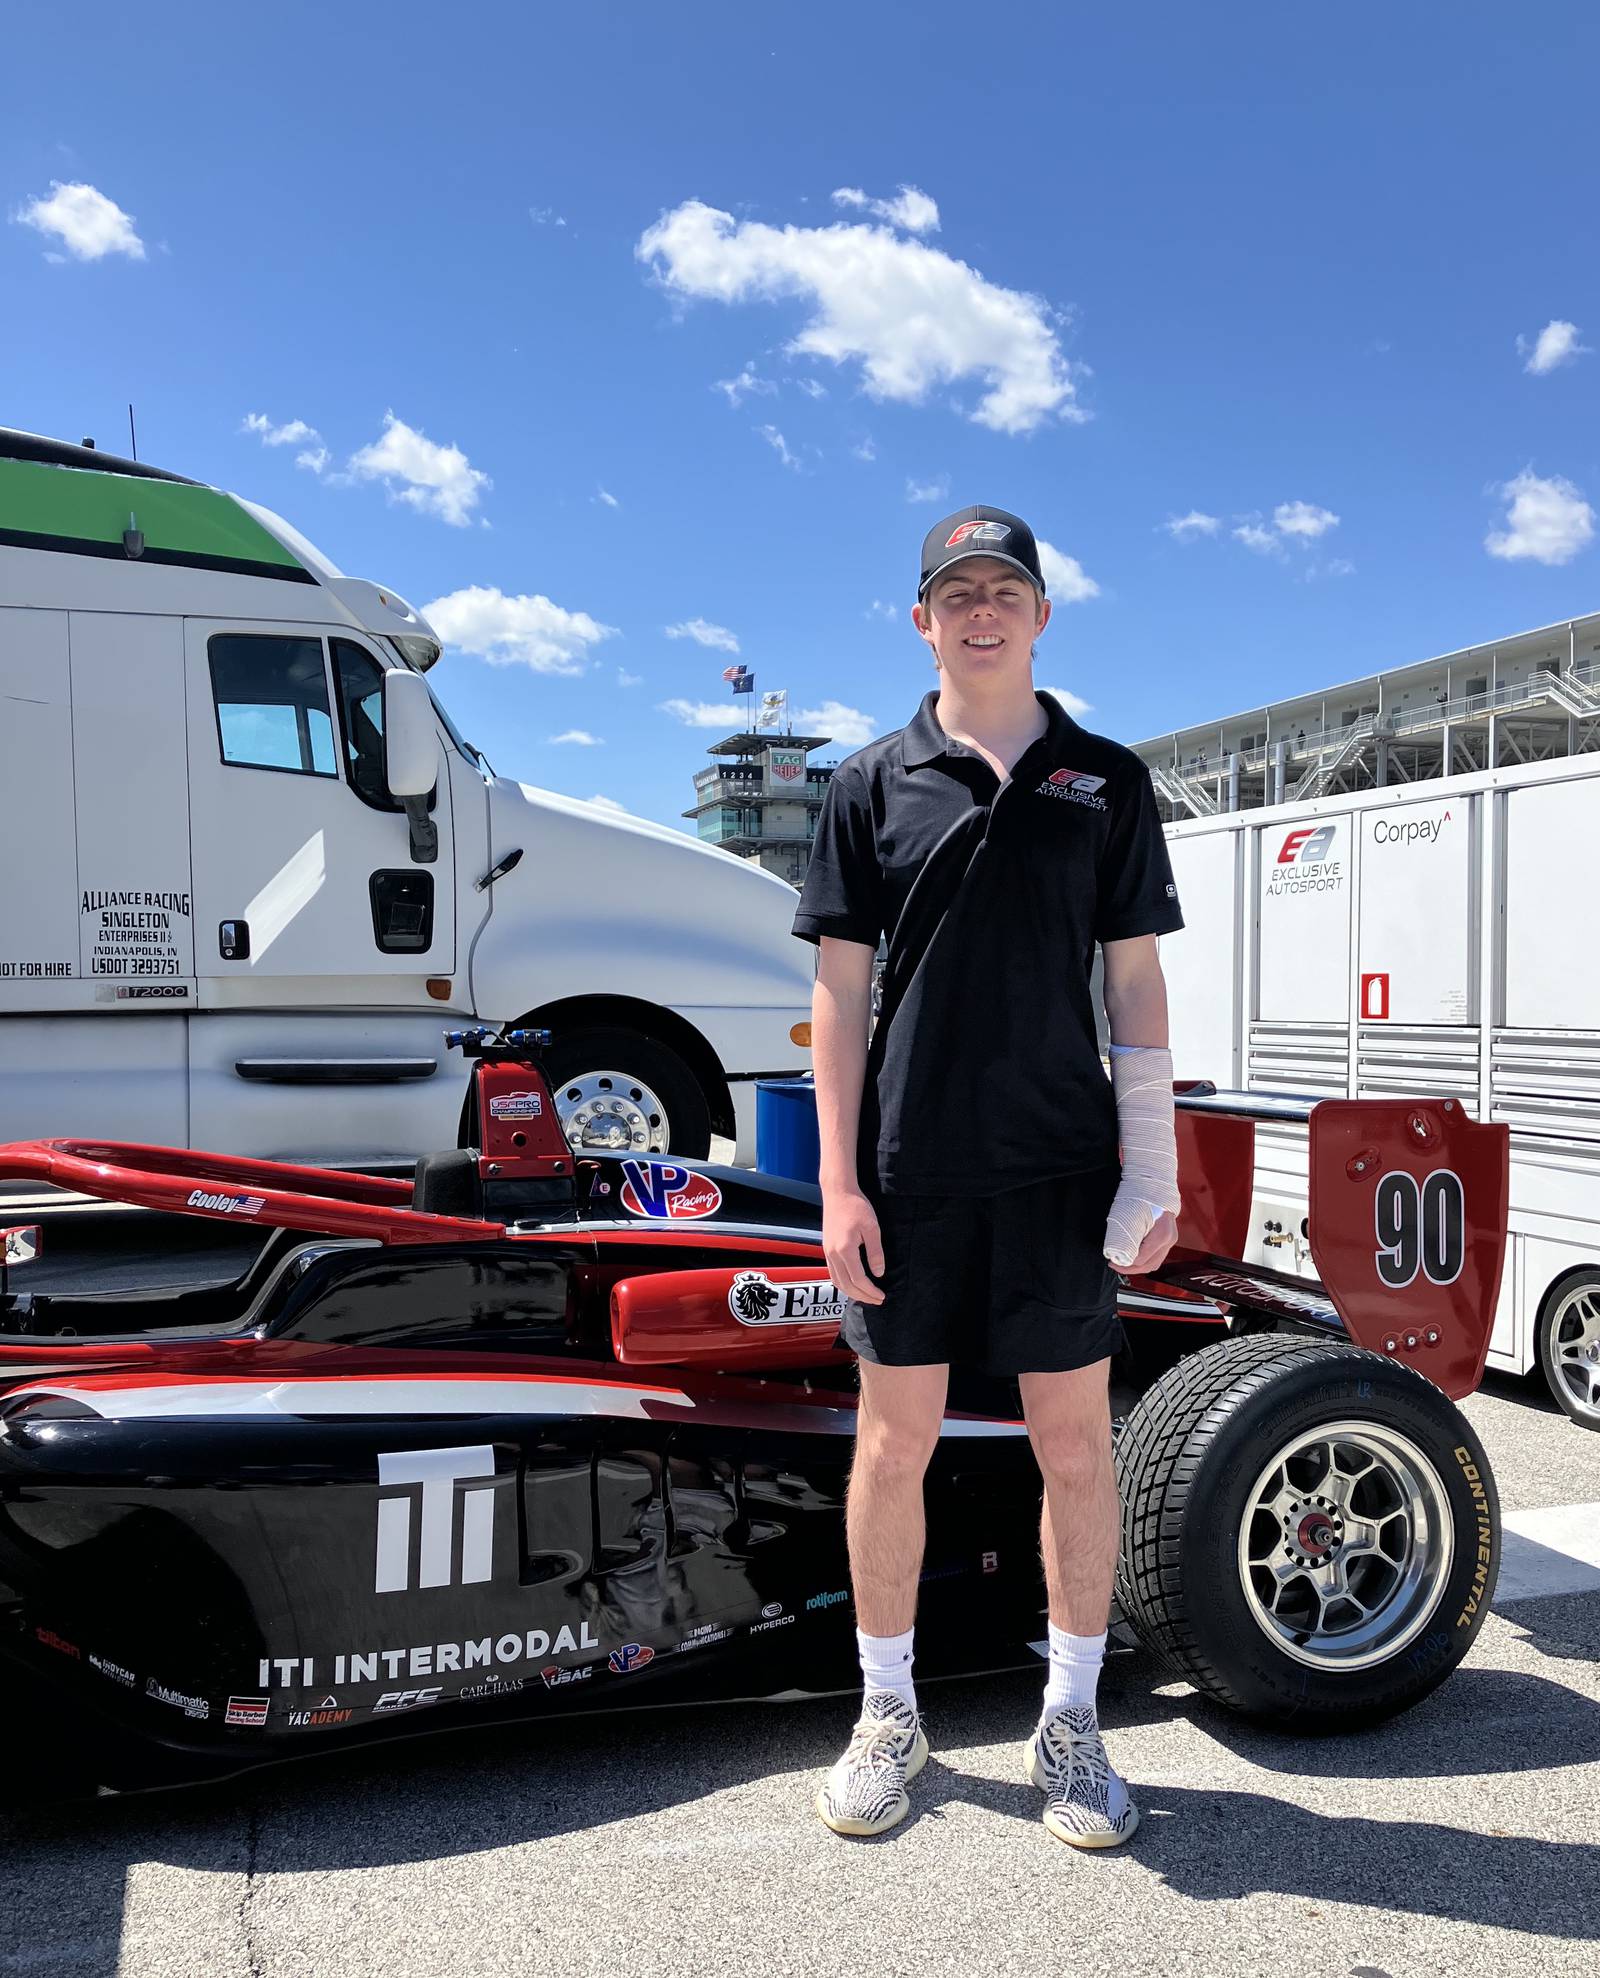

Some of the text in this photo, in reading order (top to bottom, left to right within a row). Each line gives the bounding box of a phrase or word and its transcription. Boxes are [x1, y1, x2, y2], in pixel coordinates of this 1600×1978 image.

[776, 755, 800, 764] TAG
[774, 765, 800, 779] HEUER
[1035, 788, 1109, 812] AUTOSPORT
[1041, 782, 1106, 805] EXCLUSIVE
[1374, 818, 1443, 845] Corpay
[1271, 862, 1340, 882] EXCLUSIVE
[1266, 877, 1344, 896] AUTOSPORT
[81, 891, 190, 917] ALLIANCE RACING
[101, 912, 170, 928] SINGLETON
[99, 930, 158, 943] ENTERPRISES
[94, 946, 177, 957] INDIANAPOLIS, IN
[0, 962, 72, 976] OT FOR HIRE
[92, 958, 180, 975] USDOT 3293751
[132, 987, 185, 997] T2000
[620, 1159, 690, 1218] VP
[187, 1189, 240, 1213] Cooley
[671, 1191, 719, 1213] Racing
[1375, 1168, 1465, 1288] 90
[779, 1285, 848, 1318] ELI
[812, 1304, 847, 1317] ENG
[1453, 1446, 1491, 1629] CONTINENTAL
[806, 1589, 848, 1611] rotiform
[750, 1614, 795, 1635] HYPERCO
[259, 1621, 598, 1688] ITI INTERMODAL
[609, 1642, 641, 1672] VP
[102, 1658, 136, 1682] INDYCAR
[102, 1667, 137, 1689] MINISTRY
[550, 1666, 593, 1686] USAC
[158, 1685, 209, 1711] Multimatic
[375, 1687, 443, 1707] PFC
[460, 1679, 524, 1700] CARL HAAS
[228, 1710, 242, 1718] Skip
[245, 1717, 265, 1725] School
[288, 1709, 353, 1726] YACADEMY
